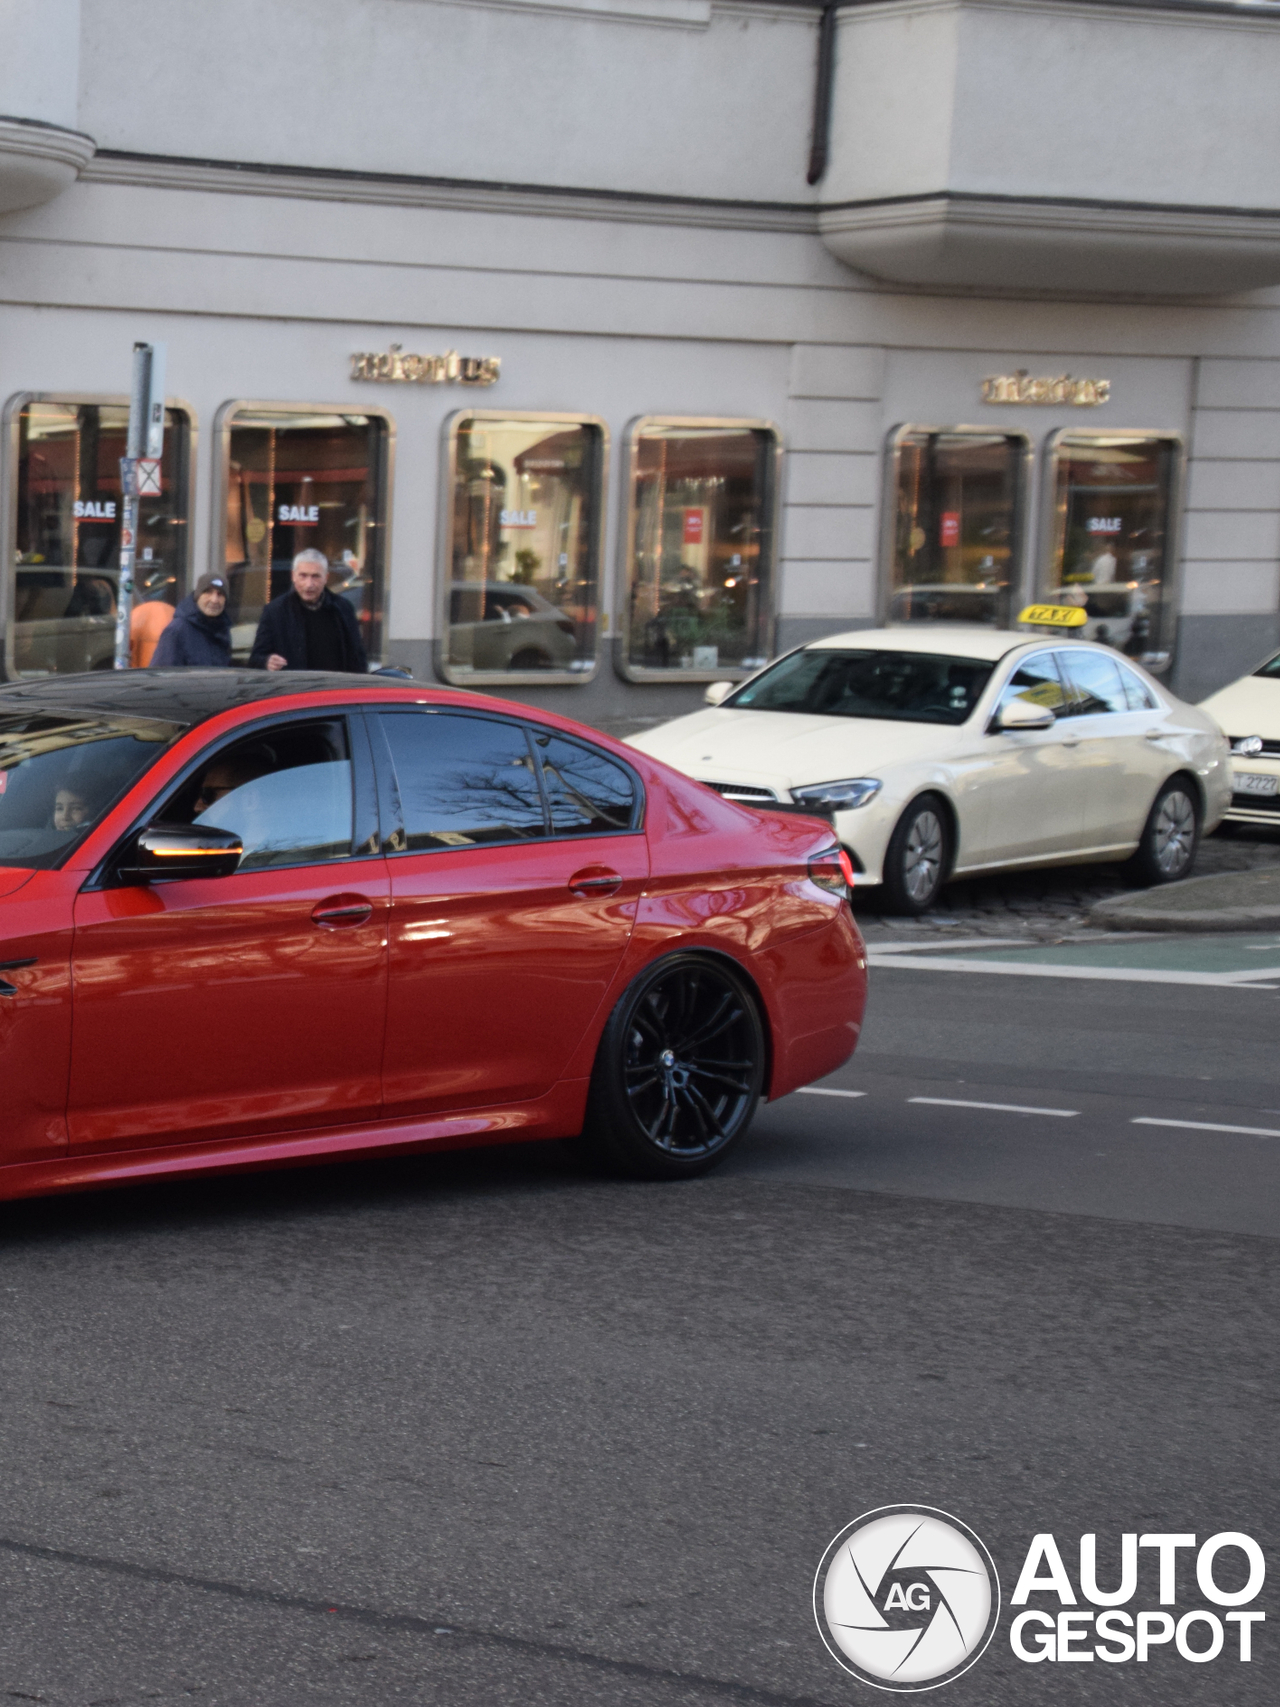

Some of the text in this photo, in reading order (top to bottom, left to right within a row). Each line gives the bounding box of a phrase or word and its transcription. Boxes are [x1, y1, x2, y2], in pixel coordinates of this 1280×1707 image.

[73, 500, 116, 518] SALE
[278, 504, 319, 521] SALE
[499, 509, 537, 525] SALE
[1088, 517, 1122, 532] SALE
[1029, 607, 1074, 622] TAXI
[1246, 775, 1278, 791] 2727
